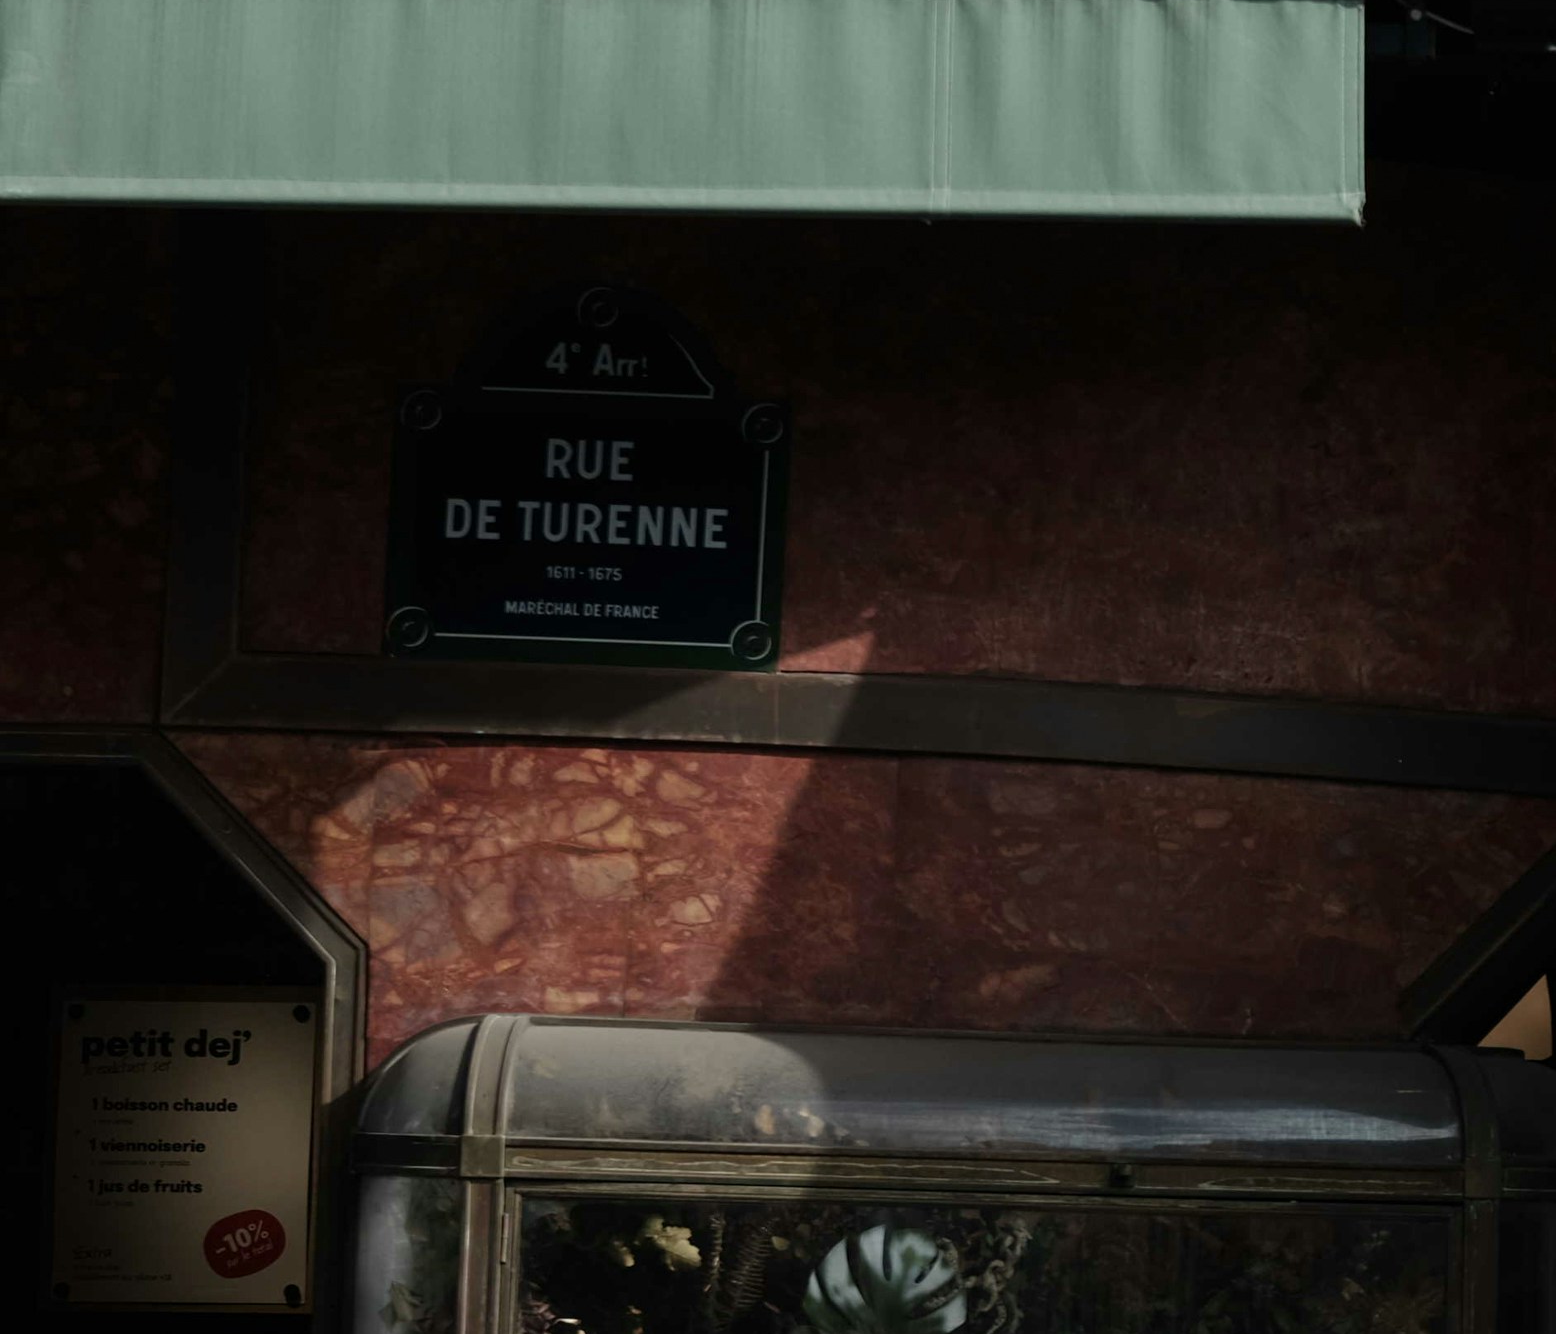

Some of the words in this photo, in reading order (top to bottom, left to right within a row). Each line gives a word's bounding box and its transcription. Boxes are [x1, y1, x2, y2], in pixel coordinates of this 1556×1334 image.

[545, 438, 635, 481] RUE
[445, 498, 502, 540] DE
[517, 500, 729, 549] TURENNE
[546, 565, 576, 579] 1611
[588, 566, 622, 581] 1675
[504, 599, 580, 616] MARÉCHAL
[583, 603, 602, 617] DE
[605, 604, 660, 619] FRANCE
[81, 1029, 174, 1065] petit
[92, 1098, 98, 1111] 1
[103, 1097, 169, 1111] boisson
[173, 1098, 238, 1112] chaude
[89, 1139, 96, 1152] 1
[101, 1138, 206, 1153] viennoiserie
[88, 1179, 94, 1192] 1
[98, 1179, 124, 1195] jus
[127, 1179, 150, 1192] de
[154, 1179, 202, 1193] fruits
[215, 1219, 270, 1255] -10%
